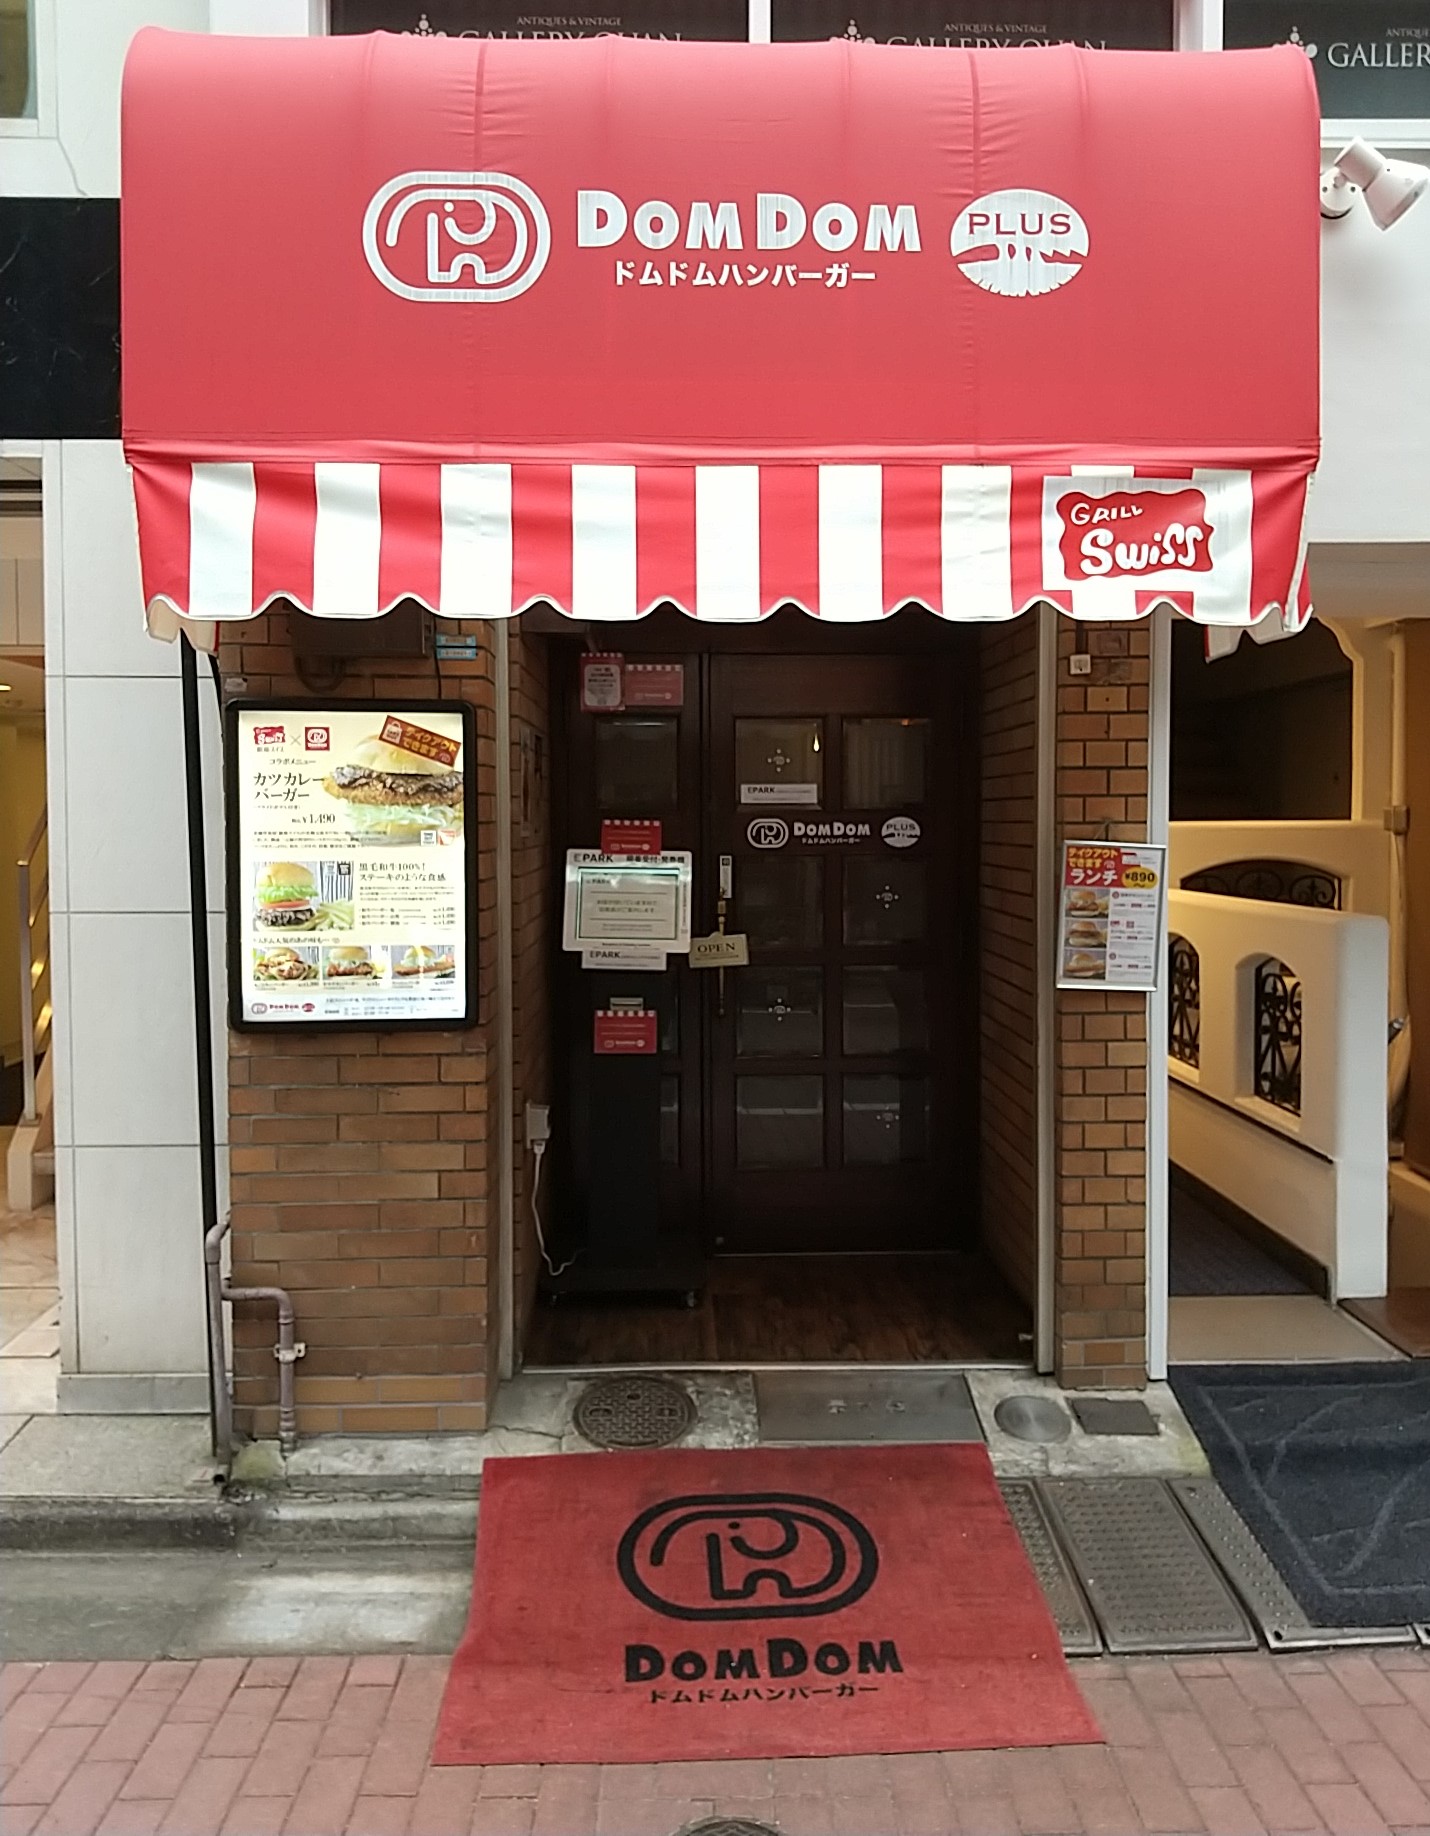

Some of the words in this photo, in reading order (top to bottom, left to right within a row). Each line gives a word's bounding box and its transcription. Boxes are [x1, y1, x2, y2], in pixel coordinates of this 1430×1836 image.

[516, 16, 567, 27] ANTIQUES
[569, 17, 577, 26] &
[578, 17, 621, 26] VINTAGE
[943, 24, 994, 34] ANTIQUES
[996, 25, 1003, 33] &
[1004, 24, 1048, 34] VINTAGE
[968, 213, 1071, 235] PLUS
[615, 260, 876, 288] ドムドムハンバーガー
[1070, 502, 1143, 526] GRILL
[1080, 522, 1204, 575] Swiss
[253, 771, 325, 786] カツカレー
[254, 787, 310, 802] バーガー
[747, 786, 776, 794] EPARK
[886, 823, 916, 832] PLUS
[573, 853, 614, 864] EPARK
[1068, 847, 1119, 859] テイクアウト
[1068, 858, 1103, 869] できます
[1070, 868, 1119, 886] ランチ
[1125, 871, 1156, 883] ¥890
[697, 942, 736, 953] OPEN
[589, 950, 621, 960] EPARK
[650, 1683, 880, 1705] ドムドムハンバーガー
